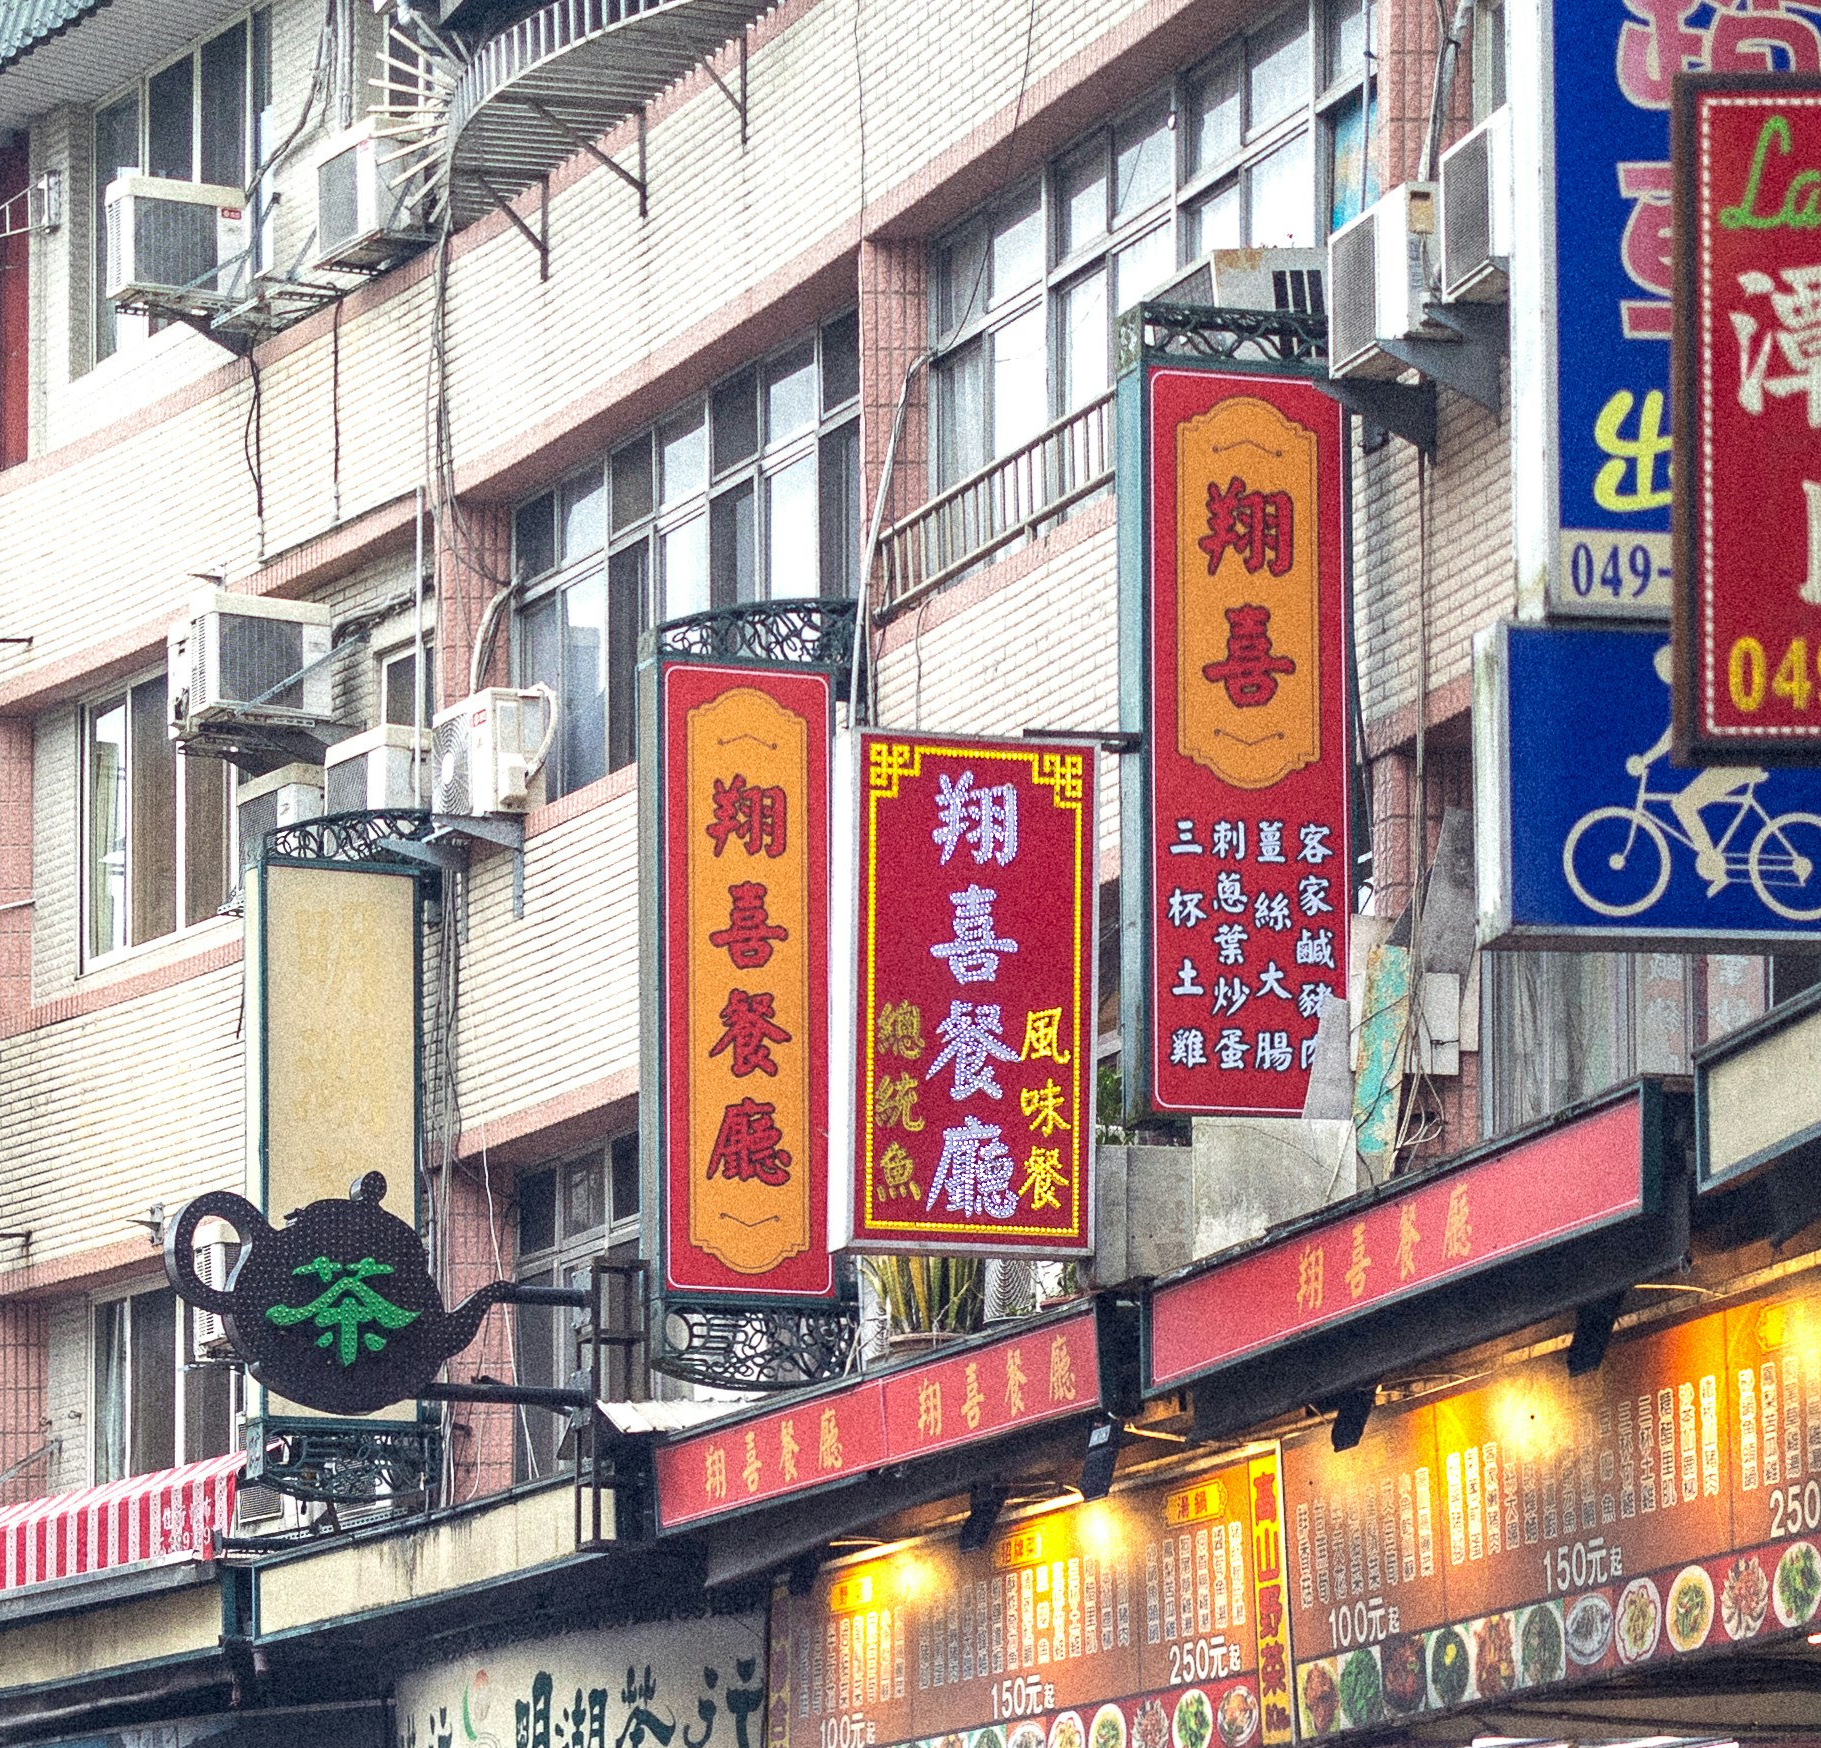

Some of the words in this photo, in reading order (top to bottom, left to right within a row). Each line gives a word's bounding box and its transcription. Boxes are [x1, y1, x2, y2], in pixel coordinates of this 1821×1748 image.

[1198, 475, 1297, 708] 翔喜
[705, 772, 791, 1187] 翔喜餐廳
[925, 771, 1021, 1219] 翔喜餐廳
[1168, 821, 1207, 1068] 三杯土雞
[1254, 821, 1292, 1070] 薑絲大腸
[877, 1001, 926, 1203] 總統魚
[1019, 1008, 1071, 1210] 風味餐
[1297, 1182, 1472, 1309] 翔喜餐廳
[266, 1256, 421, 1366] 茶
[917, 1335, 1077, 1442] 翔喜餐廳
[705, 1407, 843, 1500] 翔喜餐廳
[1329, 1597, 1400, 1650] 100元起
[1543, 1537, 1623, 1594] 150元起
[992, 1674, 1055, 1719] 150元起
[1169, 1635, 1241, 1685] 250元起
